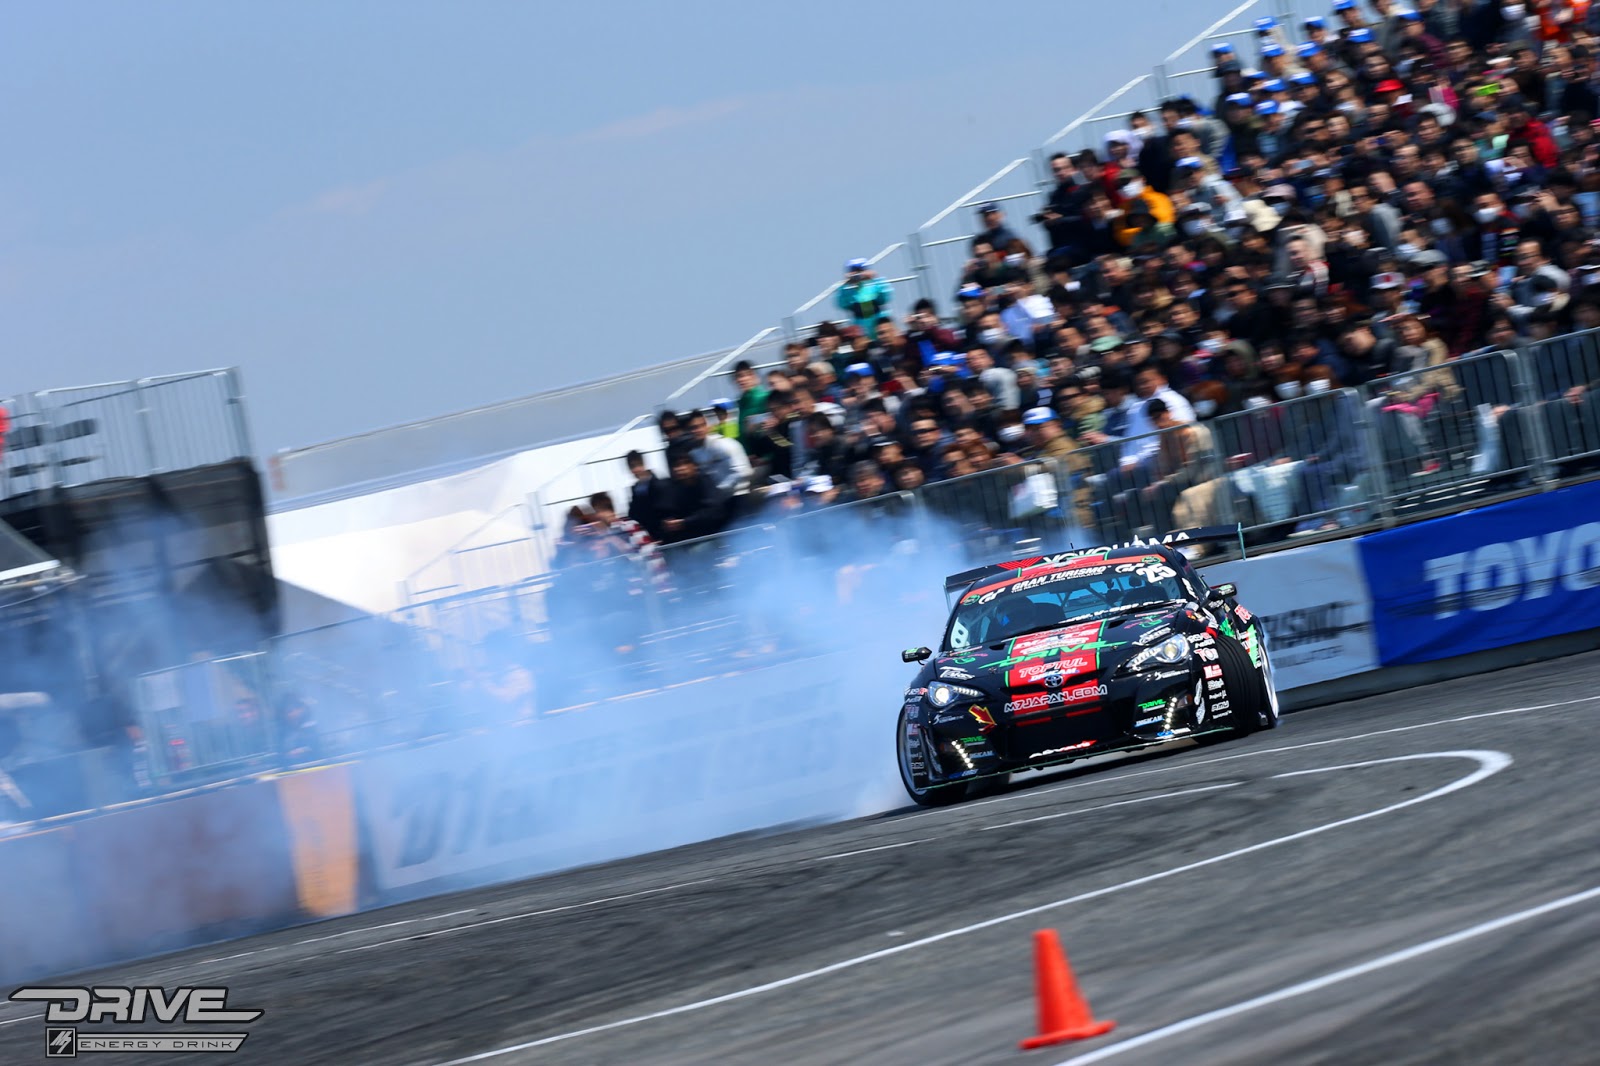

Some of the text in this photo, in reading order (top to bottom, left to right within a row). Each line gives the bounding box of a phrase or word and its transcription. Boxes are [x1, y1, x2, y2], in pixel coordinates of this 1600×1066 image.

[1012, 566, 1108, 591] GRAN TURISMO
[1136, 563, 1177, 584] 25
[978, 641, 1128, 669] DRIVE
[1018, 657, 1088, 678] TOPTUL
[1004, 683, 1108, 713] M7JAPAN.COM
[1138, 699, 1167, 710] DRIVE
